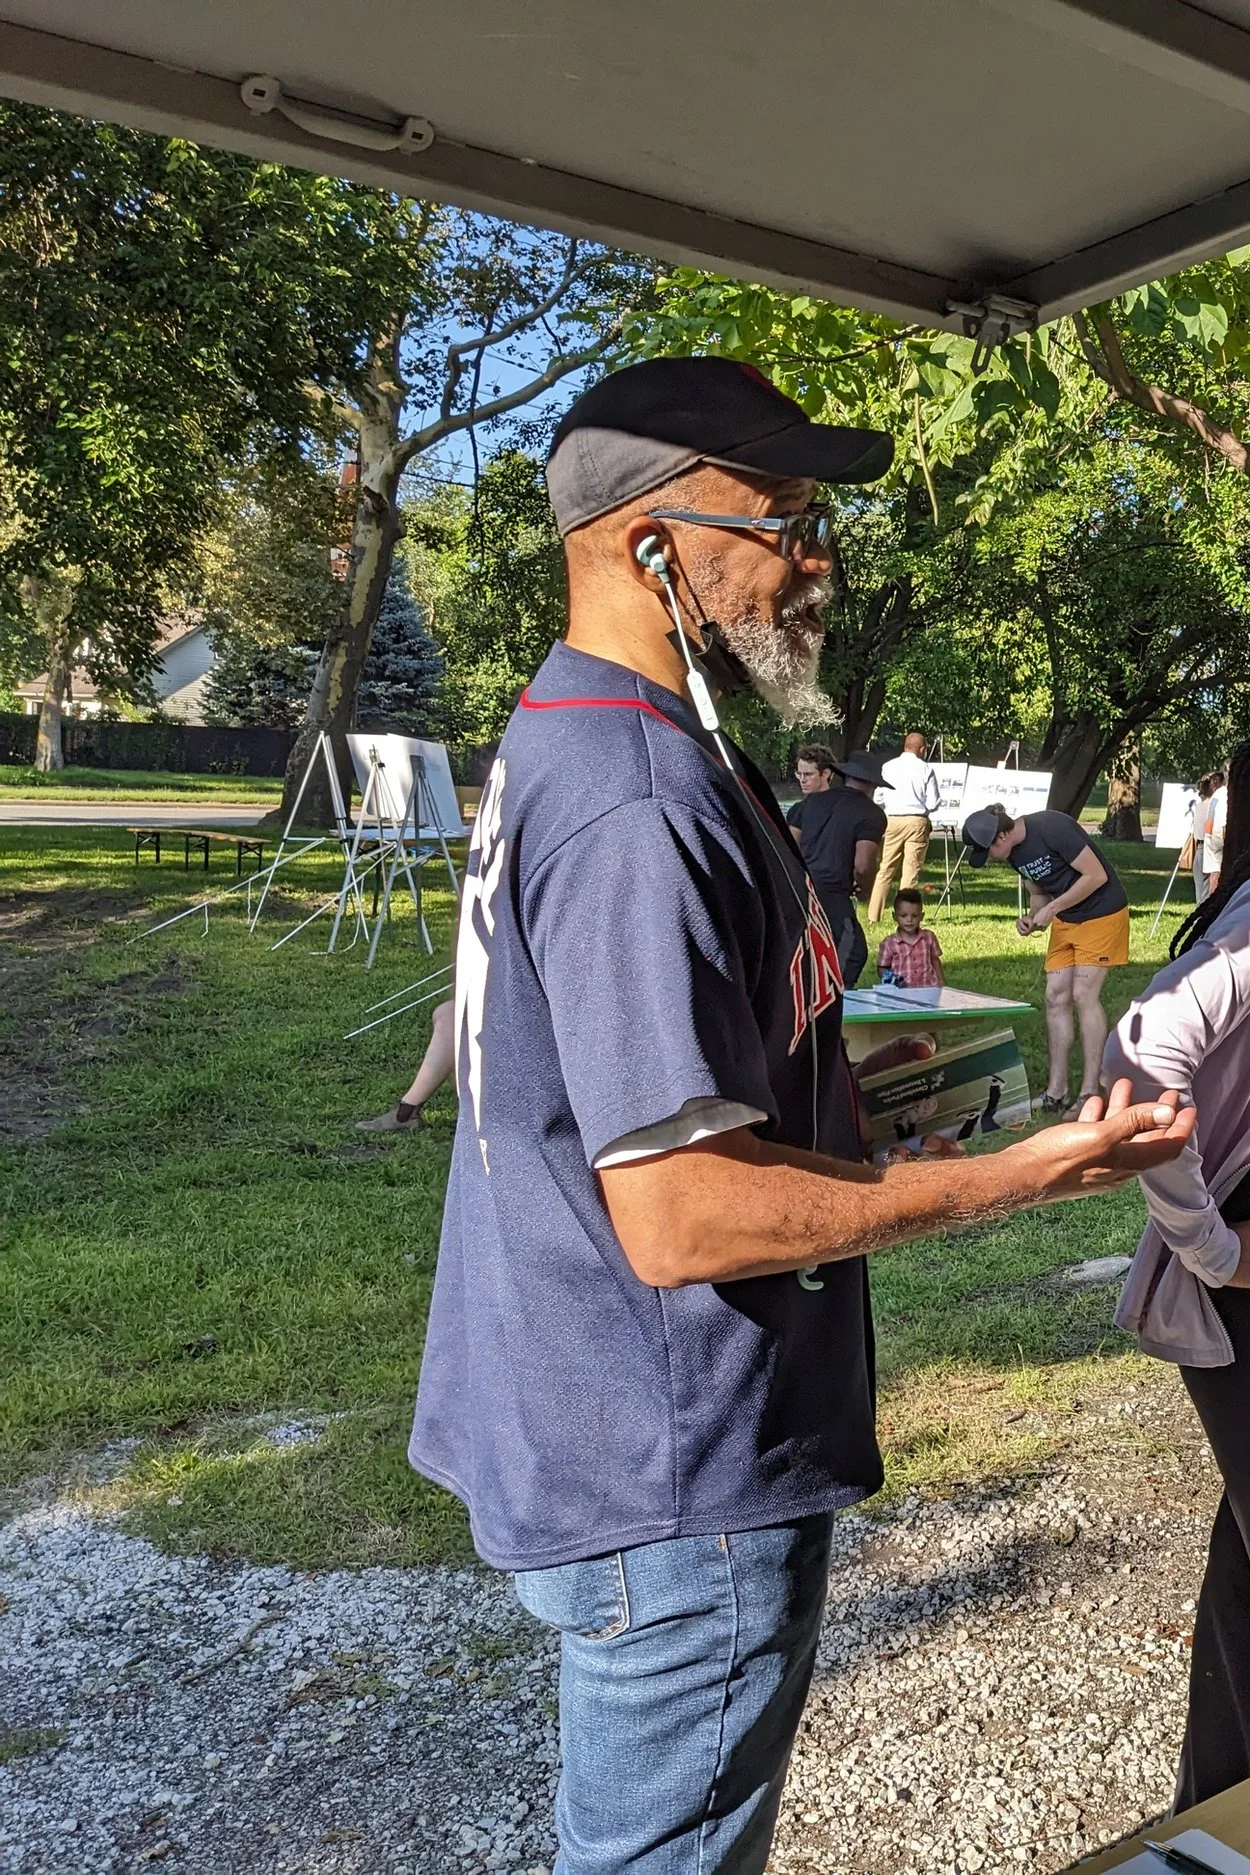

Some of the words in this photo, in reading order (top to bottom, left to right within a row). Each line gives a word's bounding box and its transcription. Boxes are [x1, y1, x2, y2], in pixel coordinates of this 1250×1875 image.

[1026, 857, 1044, 869] TRUST
[1029, 861, 1052, 875] PUBLIC
[1033, 869, 1051, 880] LAND
